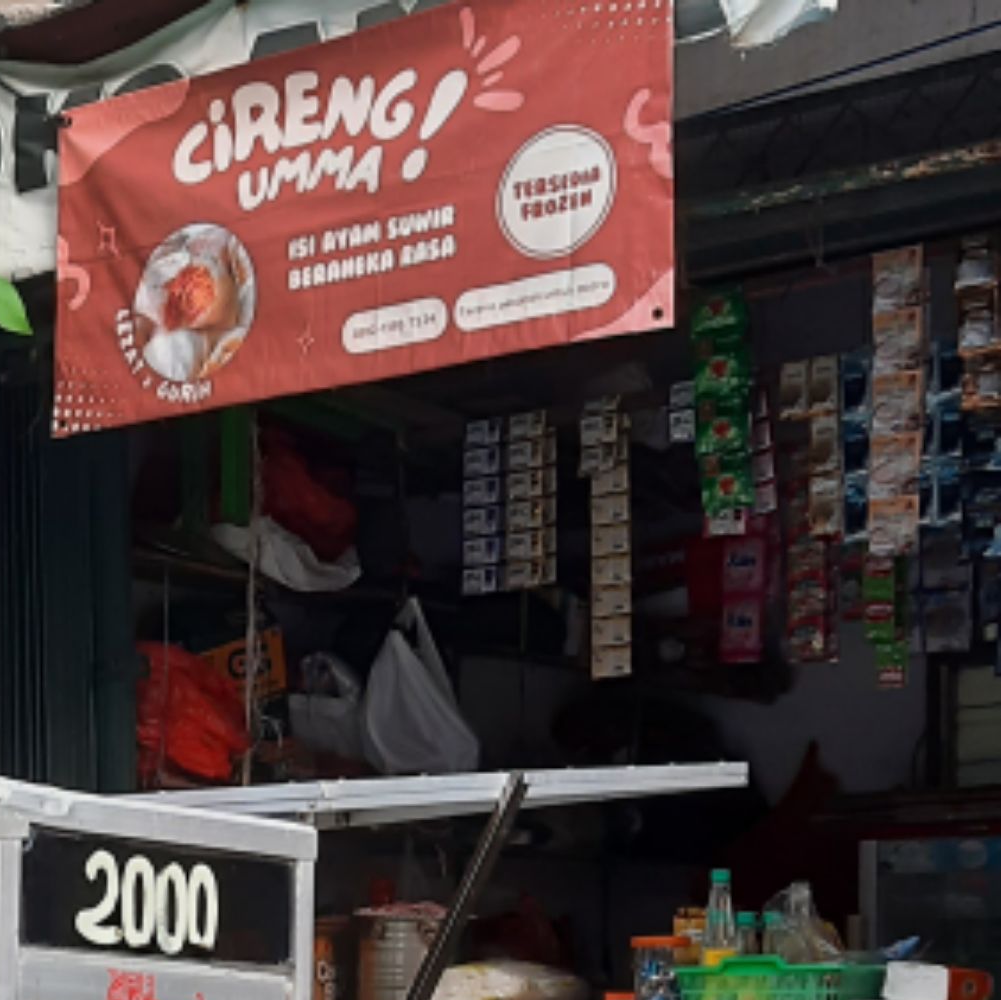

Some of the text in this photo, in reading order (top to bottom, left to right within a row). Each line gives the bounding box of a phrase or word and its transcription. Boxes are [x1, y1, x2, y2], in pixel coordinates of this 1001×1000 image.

[238, 145, 383, 211] UMMA
[521, 189, 592, 221] FROZEN
[288, 205, 455, 260] ISI AYAM SUWIR
[288, 235, 456, 290] BERANEKA RASA
[75, 849, 219, 955] 2000
